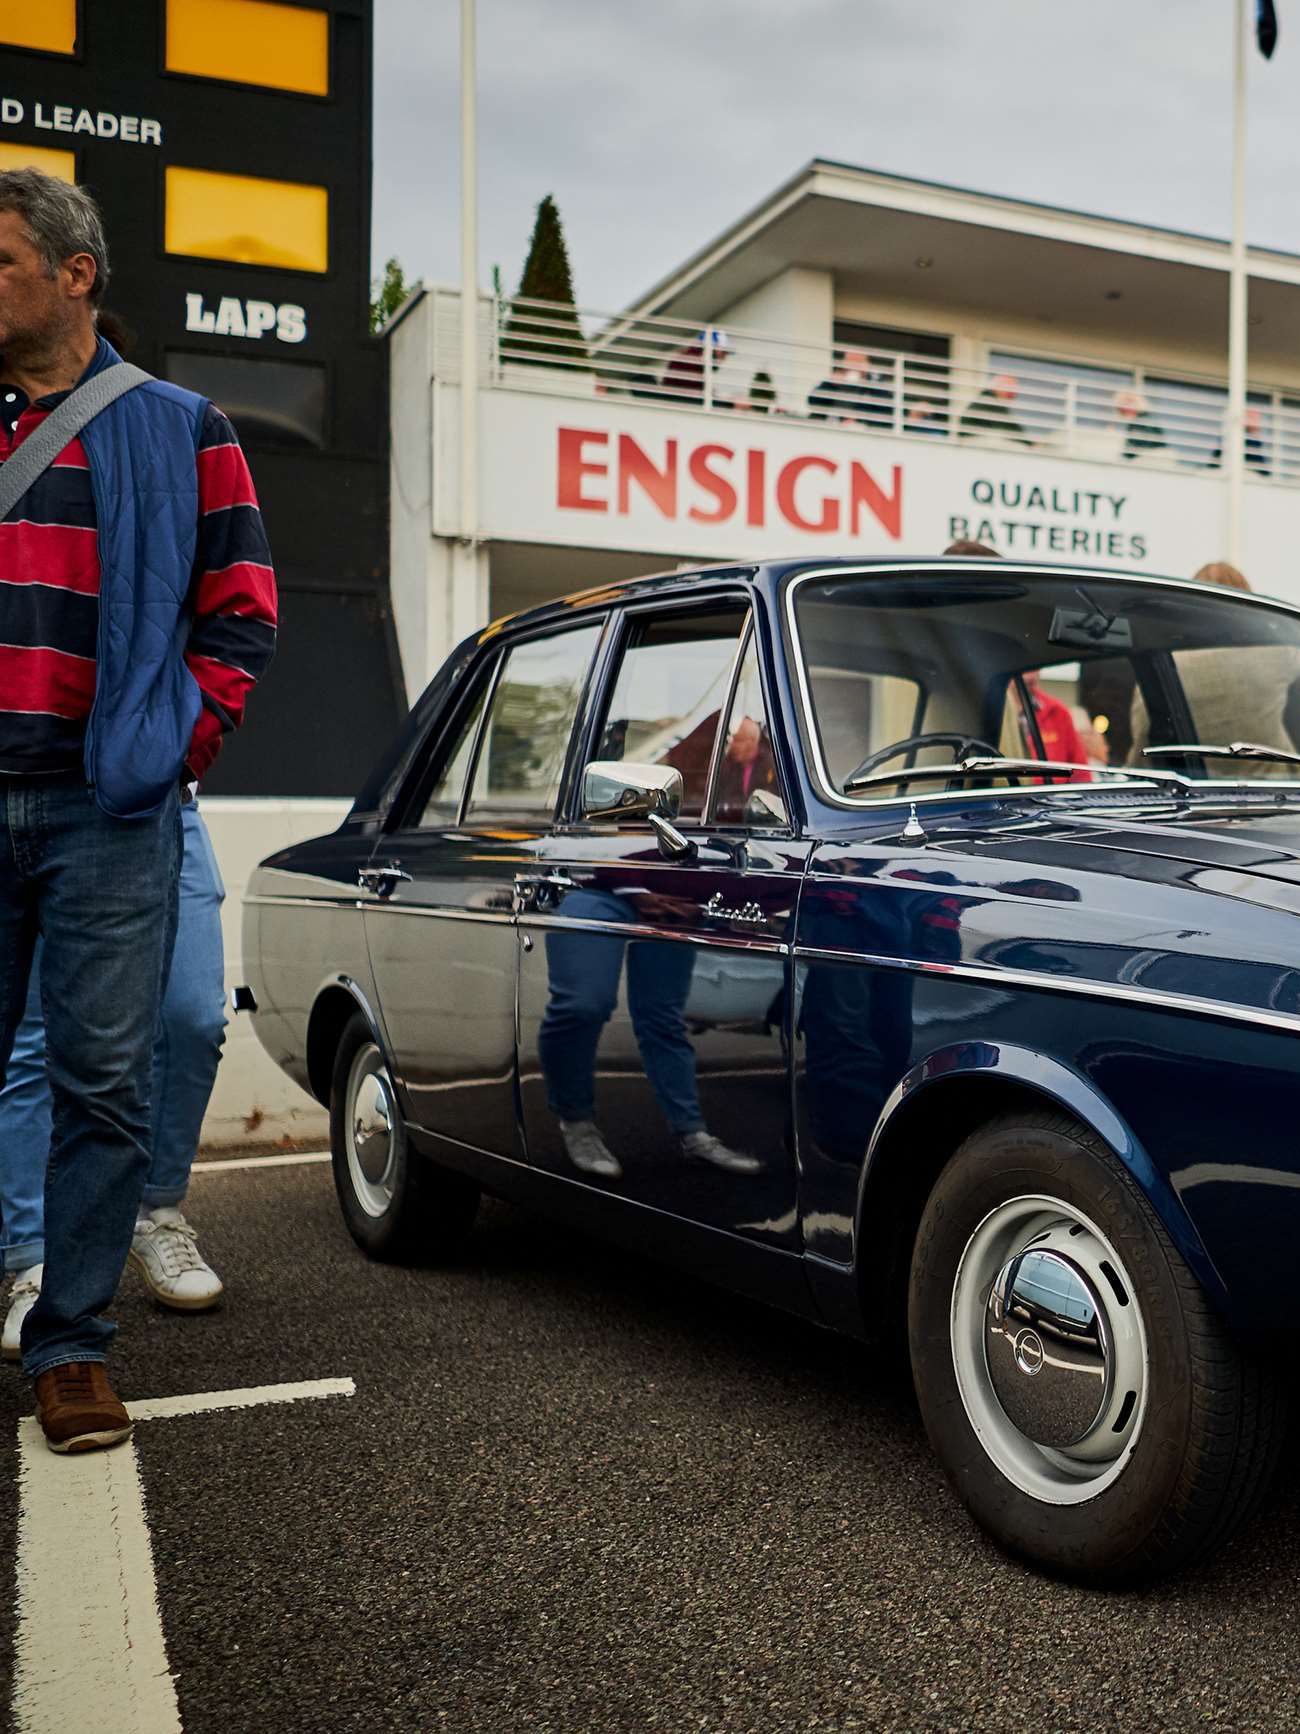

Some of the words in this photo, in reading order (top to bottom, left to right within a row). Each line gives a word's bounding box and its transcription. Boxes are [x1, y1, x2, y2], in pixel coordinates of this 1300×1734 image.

[35, 102, 162, 146] LEADER
[185, 293, 307, 343] LAPS
[557, 427, 904, 542] ENSIGN
[971, 479, 1127, 519] QUALITY
[949, 516, 1148, 560] BATTERIES
